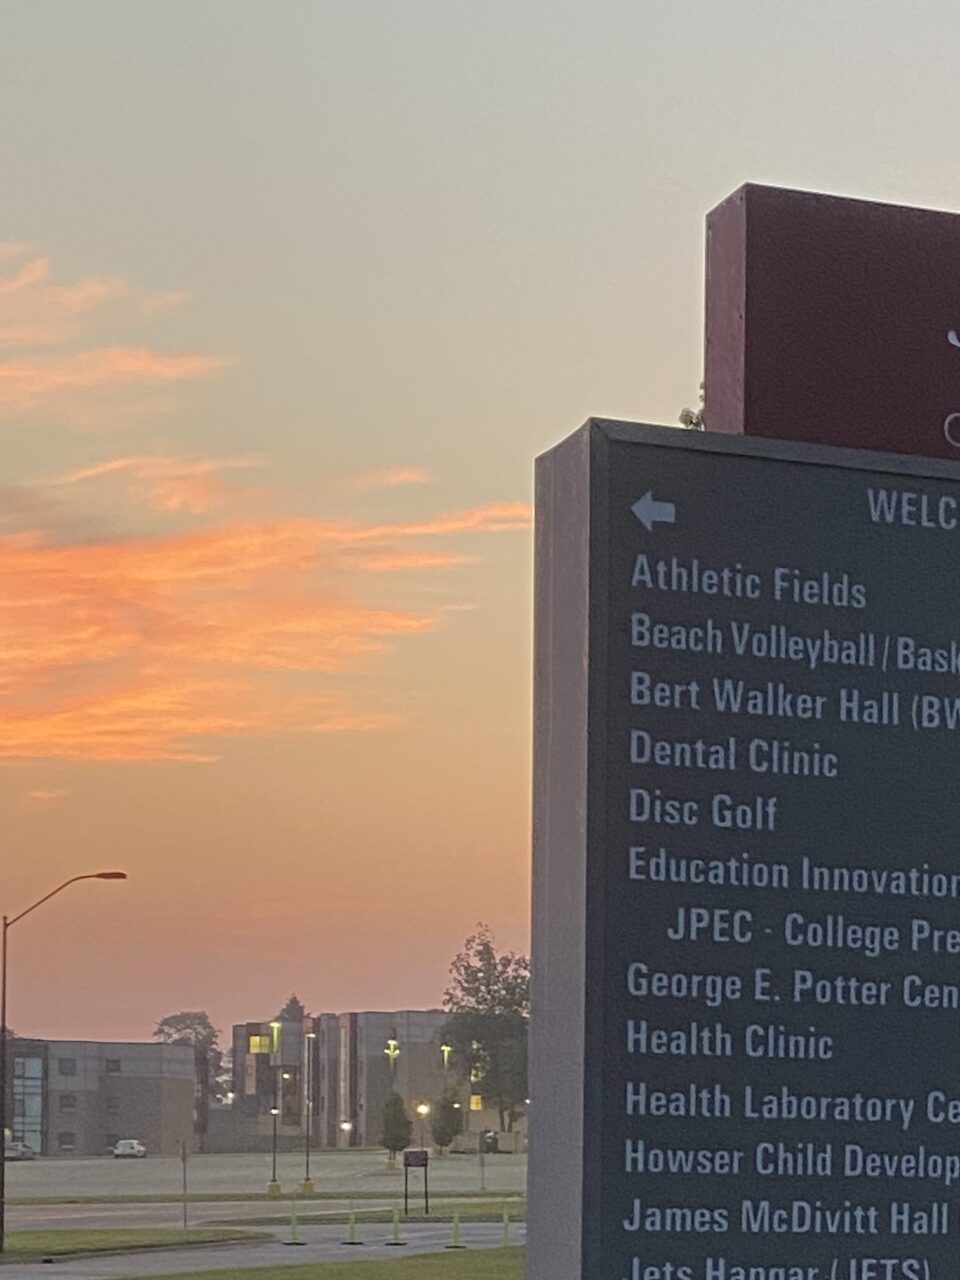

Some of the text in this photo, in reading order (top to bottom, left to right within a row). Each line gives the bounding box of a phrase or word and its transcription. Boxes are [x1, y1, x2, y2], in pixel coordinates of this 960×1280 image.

[631, 554, 867, 609] Athletic Fields
[631, 612, 723, 654] Beach
[630, 671, 700, 710] Bert
[712, 677, 827, 719] Walker
[839, 688, 899, 725] Hall
[630, 729, 838, 778] Dental Clinic
[629, 788, 777, 831] Disc Golf
[629, 846, 789, 888] Education
[667, 907, 753, 943] JPEC
[784, 912, 900, 958] College
[627, 962, 742, 1007] George
[754, 968, 781, 1002] E.
[793, 969, 891, 1006] Potter
[627, 1019, 833, 1060] Health Clinic
[626, 1082, 731, 1117] Health
[744, 1085, 915, 1131] Laboratory
[625, 1139, 744, 1174] Howser
[756, 1142, 832, 1176] Child
[623, 1198, 729, 1233] James
[741, 1200, 878, 1234] McDivitt
[890, 1202, 948, 1234] Hall
